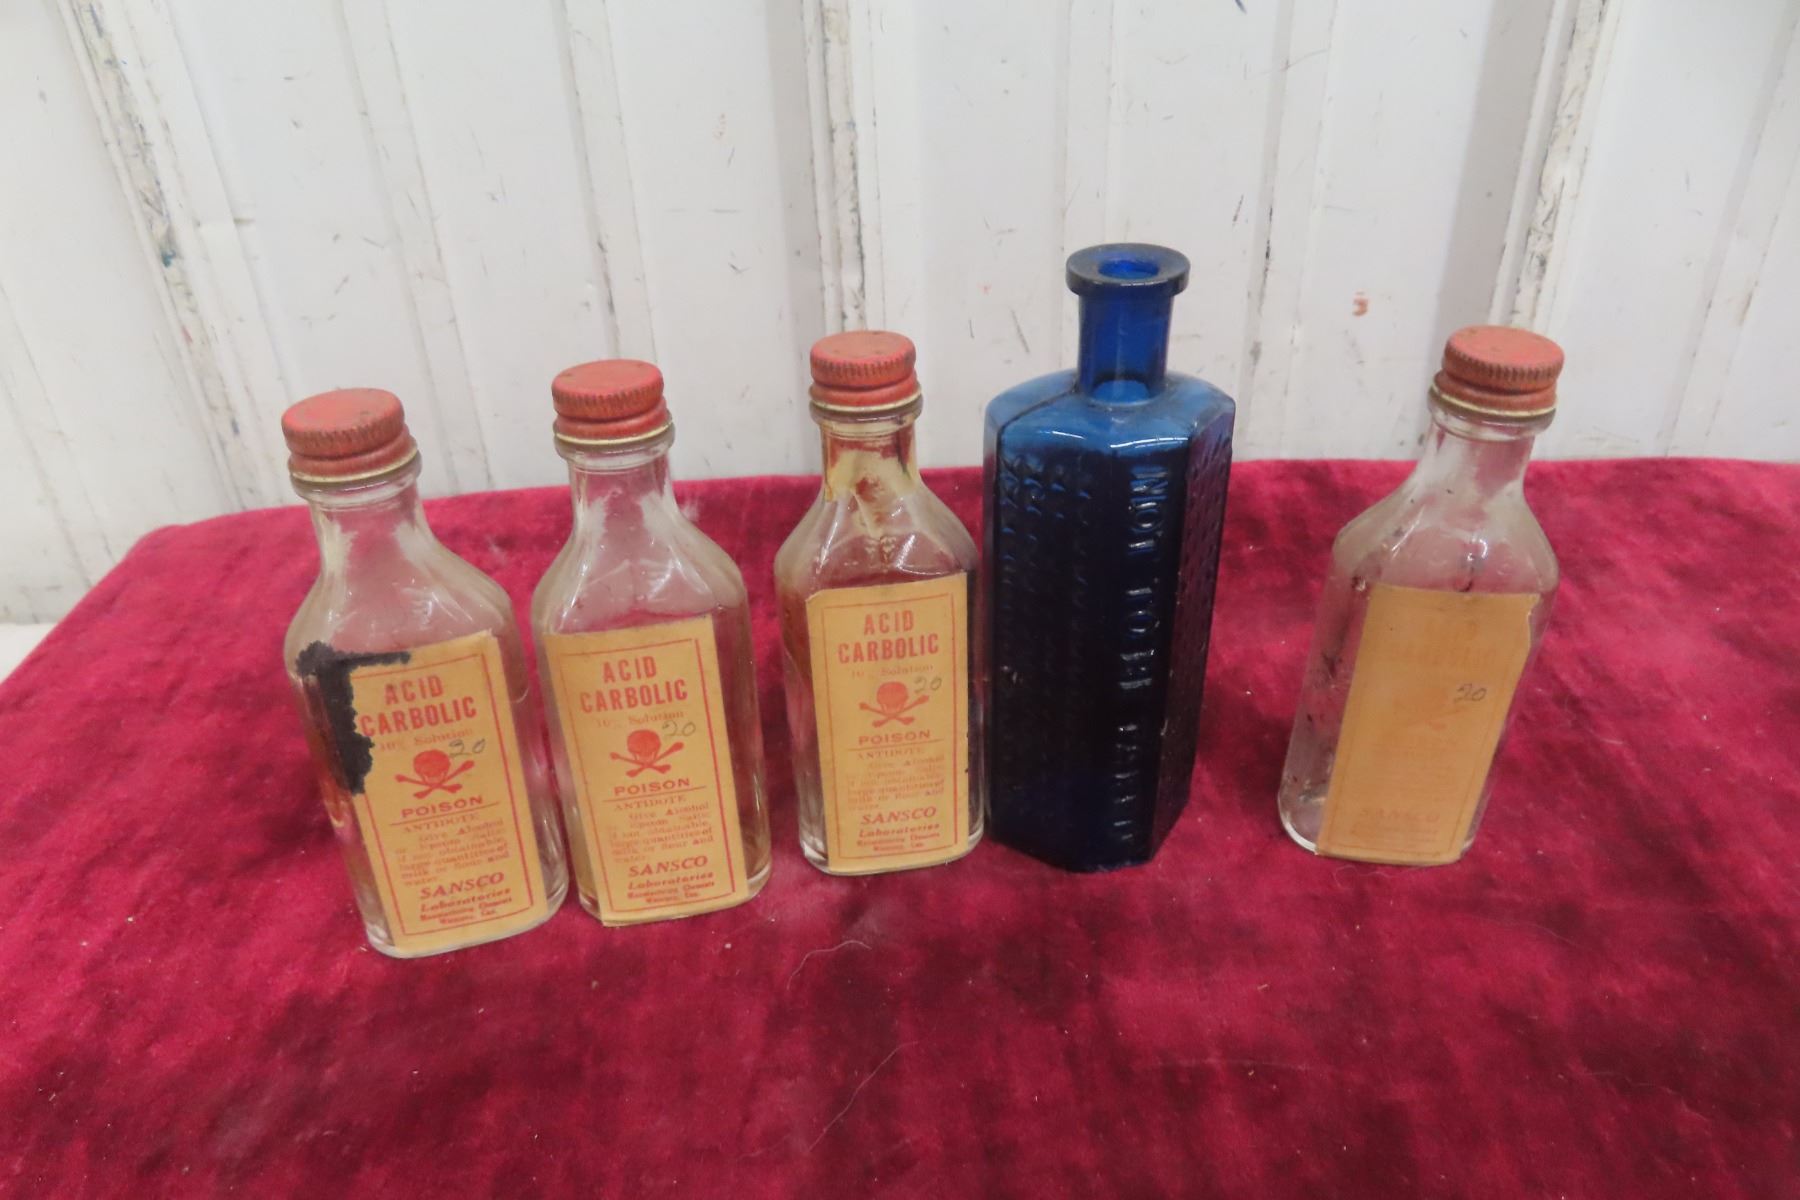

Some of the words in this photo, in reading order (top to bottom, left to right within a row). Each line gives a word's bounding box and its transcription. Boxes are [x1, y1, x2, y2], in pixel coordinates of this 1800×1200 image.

[1128, 464, 1169, 560] NOT
[864, 610, 914, 635] ACID
[837, 633, 939, 664] CARBOLIC
[603, 655, 657, 684] ACID
[385, 675, 443, 706] ACID
[913, 676, 942, 694] 20
[1454, 683, 1487, 703] 20
[579, 679, 688, 714] CARBOLIC
[359, 696, 477, 737] CARBOLIC
[662, 720, 697, 738] 20
[858, 729, 931, 745] POISON
[448, 738, 486, 758] 20
[613, 778, 690, 796] POISON
[401, 795, 483, 818] POISON
[613, 794, 687, 811] ANTIDOTE
[404, 812, 481, 833] ANTIDOTE
[860, 806, 937, 826] SANSCO
[859, 822, 940, 839] Laboratories
[629, 855, 708, 878] SANSCO
[420, 871, 505, 900] SANSCO
[628, 871, 714, 891] Laboratories
[420, 888, 511, 912] Laboratories
